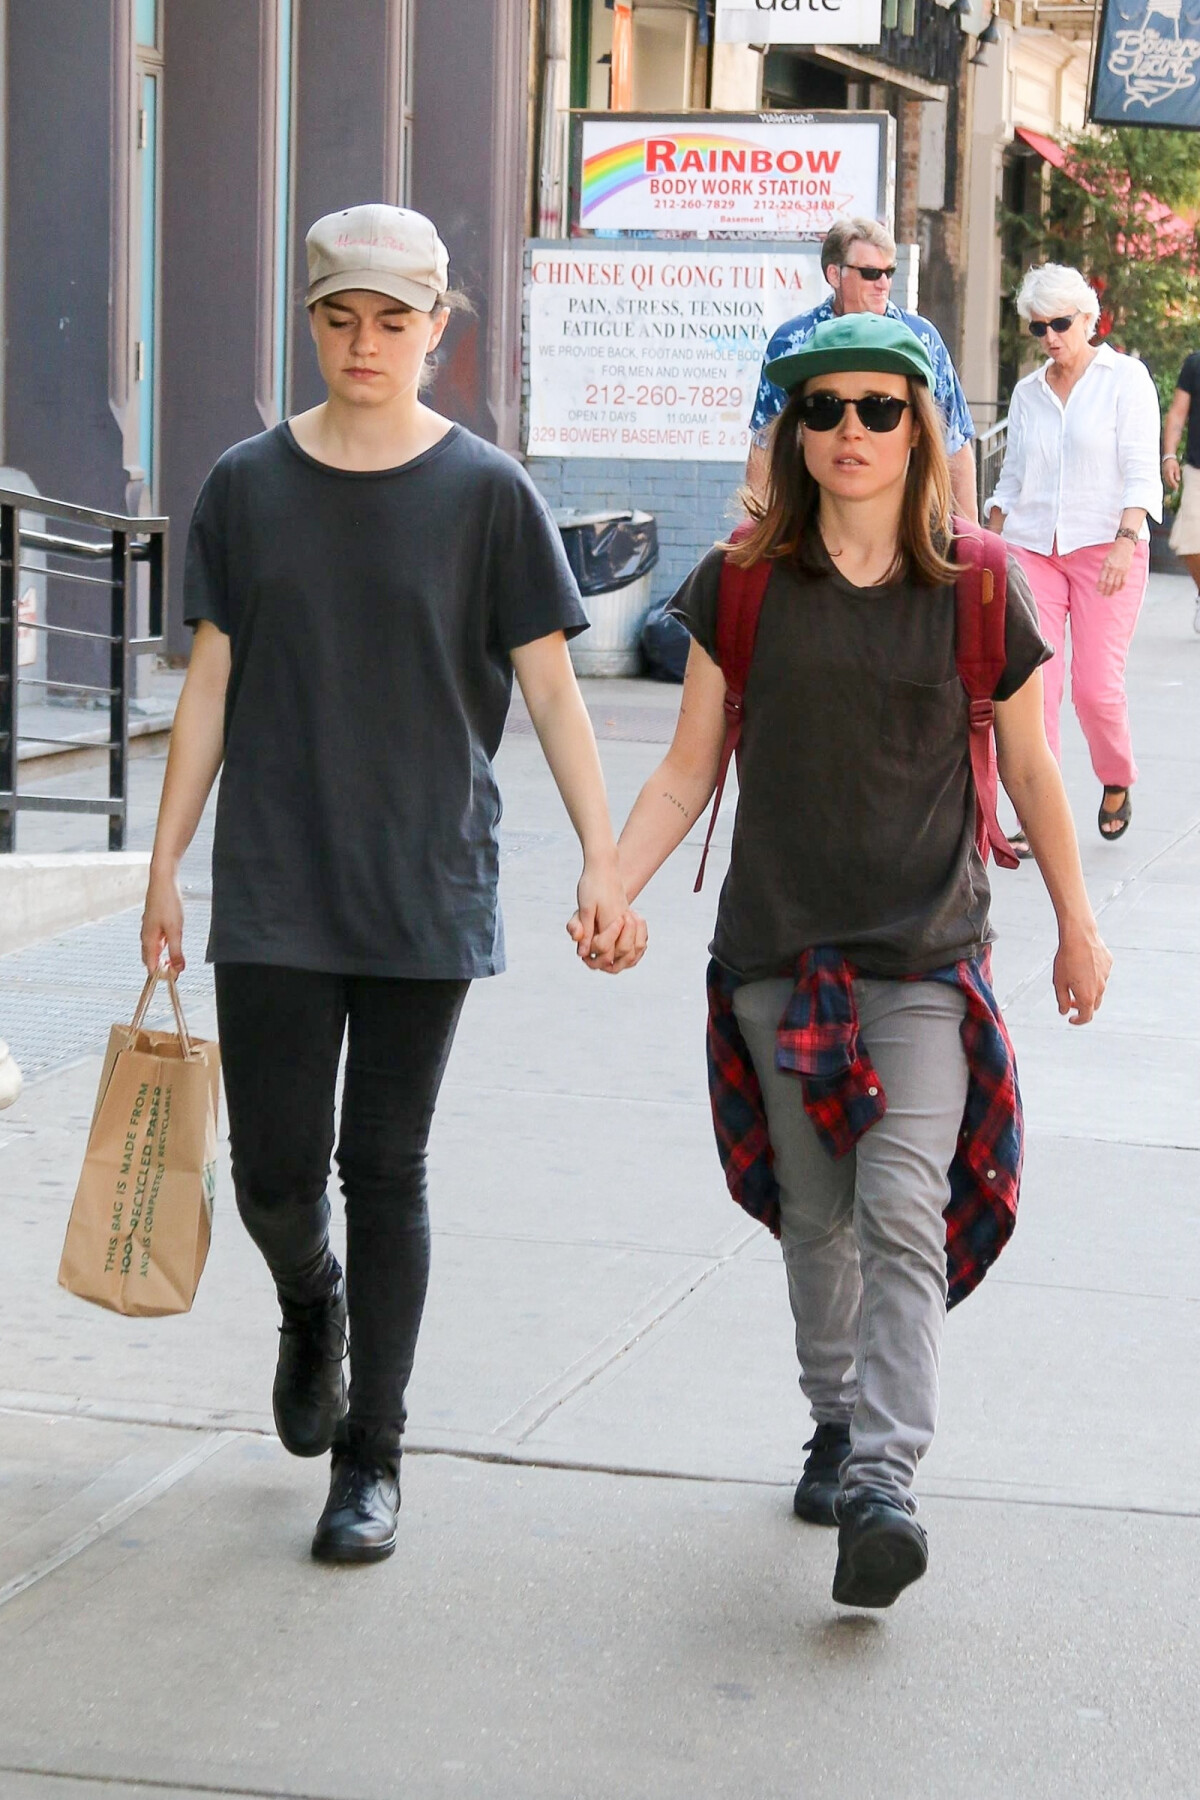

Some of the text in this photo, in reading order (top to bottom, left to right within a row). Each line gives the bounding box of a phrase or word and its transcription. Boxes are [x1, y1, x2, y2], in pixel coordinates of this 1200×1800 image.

[645, 140, 841, 173] RAINBOW
[650, 179, 831, 196] BODY WORK STATION
[654, 199, 735, 210] 212-260-7829
[532, 261, 803, 291] CHINESE QI GONG TUI NA
[569, 298, 611, 316] PAIN,
[616, 299, 684, 317] STRESS,
[563, 320, 769, 340] FATIGUE AND INSOMNIA
[539, 345, 556, 356] WE
[558, 346, 604, 358] PROVIDE
[696, 350, 734, 361] WHOLE
[602, 365, 727, 379] FOR MEN AND WOMEN
[585, 384, 743, 408] 212-260-7829
[568, 410, 600, 421] OPEN
[601, 410, 607, 421] 7
[610, 411, 637, 422] DAYS
[532, 426, 556, 442] 329
[560, 427, 617, 443] BOWERY
[621, 428, 694, 445] BASEMENT
[698, 430, 714, 447] (E.
[718, 431, 725, 445] 2
[740, 432, 748, 446] 3
[105, 1083, 149, 1273] THIS BAG IS MADE FROM
[130, 1145, 152, 1228] RECYCLED
[144, 1163, 165, 1233] COMPLETELY
[143, 1237, 151, 1249] IS
[140, 1252, 150, 1278] AND
